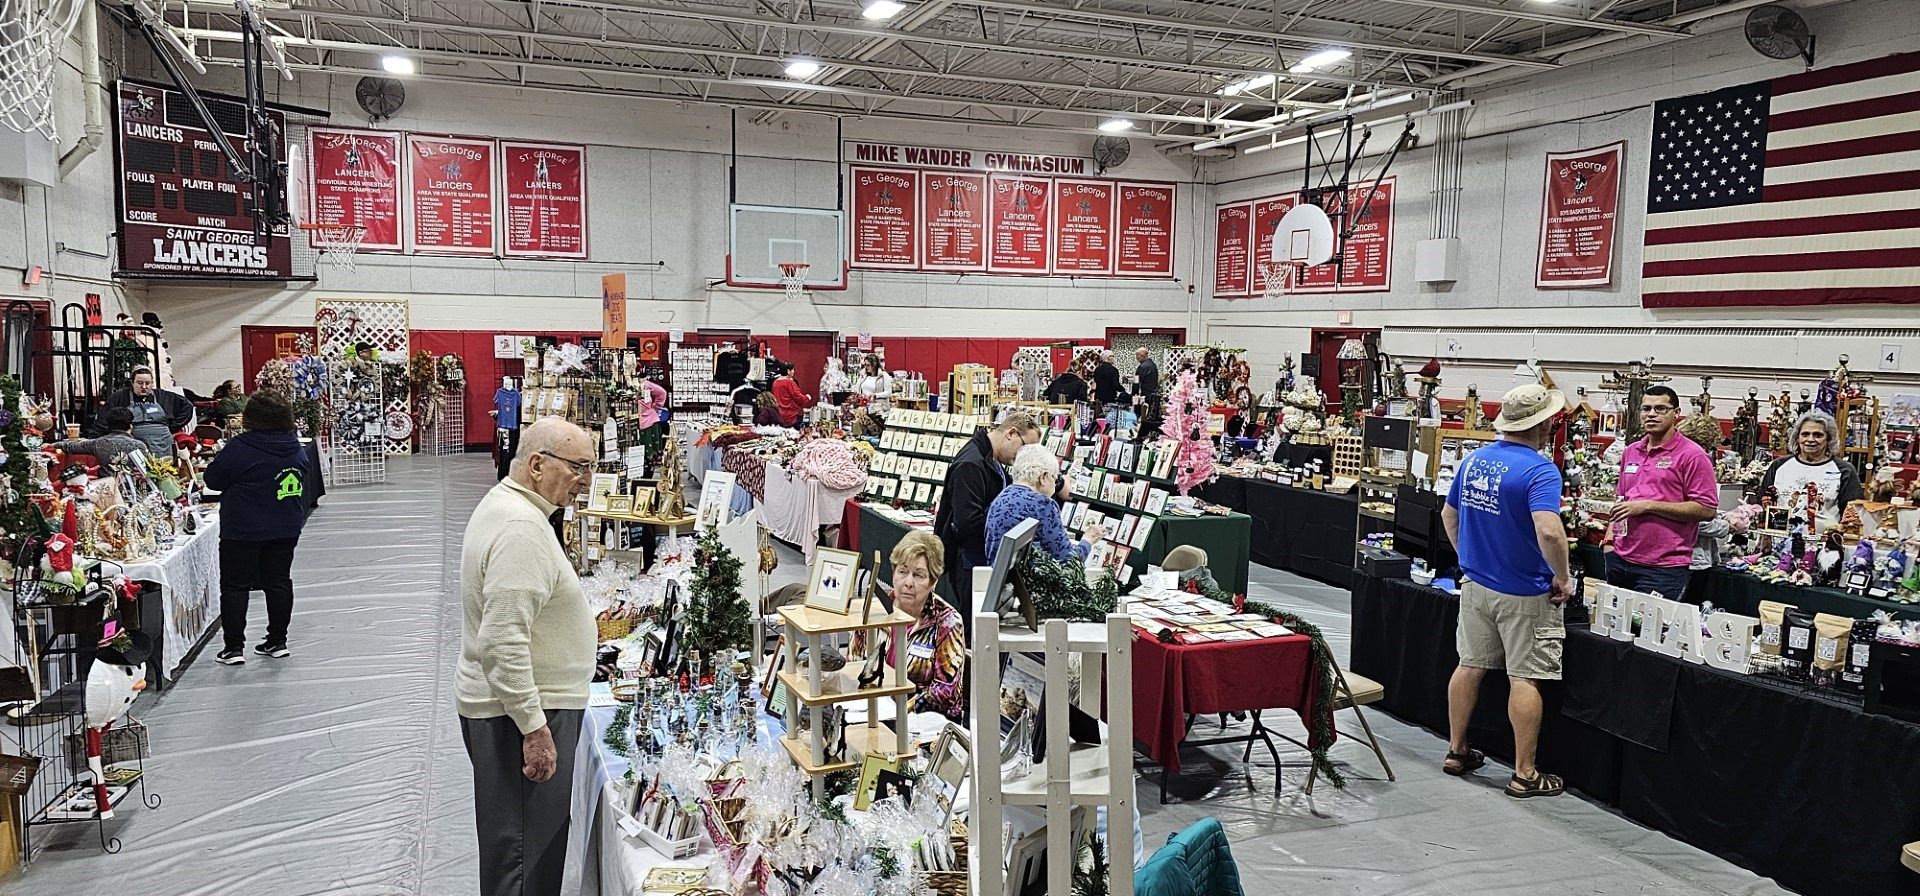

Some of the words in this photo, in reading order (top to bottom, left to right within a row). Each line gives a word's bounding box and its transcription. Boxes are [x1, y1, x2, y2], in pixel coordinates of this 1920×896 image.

[126, 121, 184, 143] LANCERS
[420, 146, 436, 157] St.
[439, 144, 482, 161] George
[519, 153, 532, 163] ST.
[534, 151, 568, 165] GEORGE
[856, 144, 899, 162] MIKE
[904, 147, 972, 167] WANDER
[984, 153, 1084, 174] GYMNASIUM
[335, 169, 374, 177] LANCERS
[1570, 161, 1607, 173] George
[126, 171, 155, 184] FOULS
[860, 176, 872, 186] St.
[876, 173, 910, 189] George
[182, 178, 214, 191] PLAYER
[217, 182, 238, 194] FOUL
[429, 178, 472, 190] Lancers
[526, 181, 562, 189] LANCERS
[931, 181, 944, 190] St.
[946, 177, 978, 192] George
[997, 184, 1011, 194] St.
[1013, 181, 1043, 196] George
[1062, 187, 1075, 197] St.
[1077, 184, 1106, 199] George
[1125, 190, 1136, 200] St.
[1139, 188, 1167, 201] George
[1563, 195, 1593, 205] Lancers
[868, 204, 902, 214] Lancers
[939, 208, 971, 217] Lancers
[1269, 202, 1290, 213] George
[1570, 207, 1601, 215] BASKETBALL
[129, 210, 158, 222] SCORE
[1004, 211, 1035, 220] Lancers
[1068, 214, 1098, 223] Lancers
[1228, 209, 1247, 219] George
[197, 216, 226, 228] MATCH
[1130, 217, 1160, 225] Lancers
[166, 228, 203, 241] SAINT
[206, 231, 255, 245] GEORGE
[153, 238, 268, 268] LANCERS
[1886, 352, 1894, 363] 4
[450, 371, 460, 379] JOY
[1470, 489, 1489, 502] Bubble
